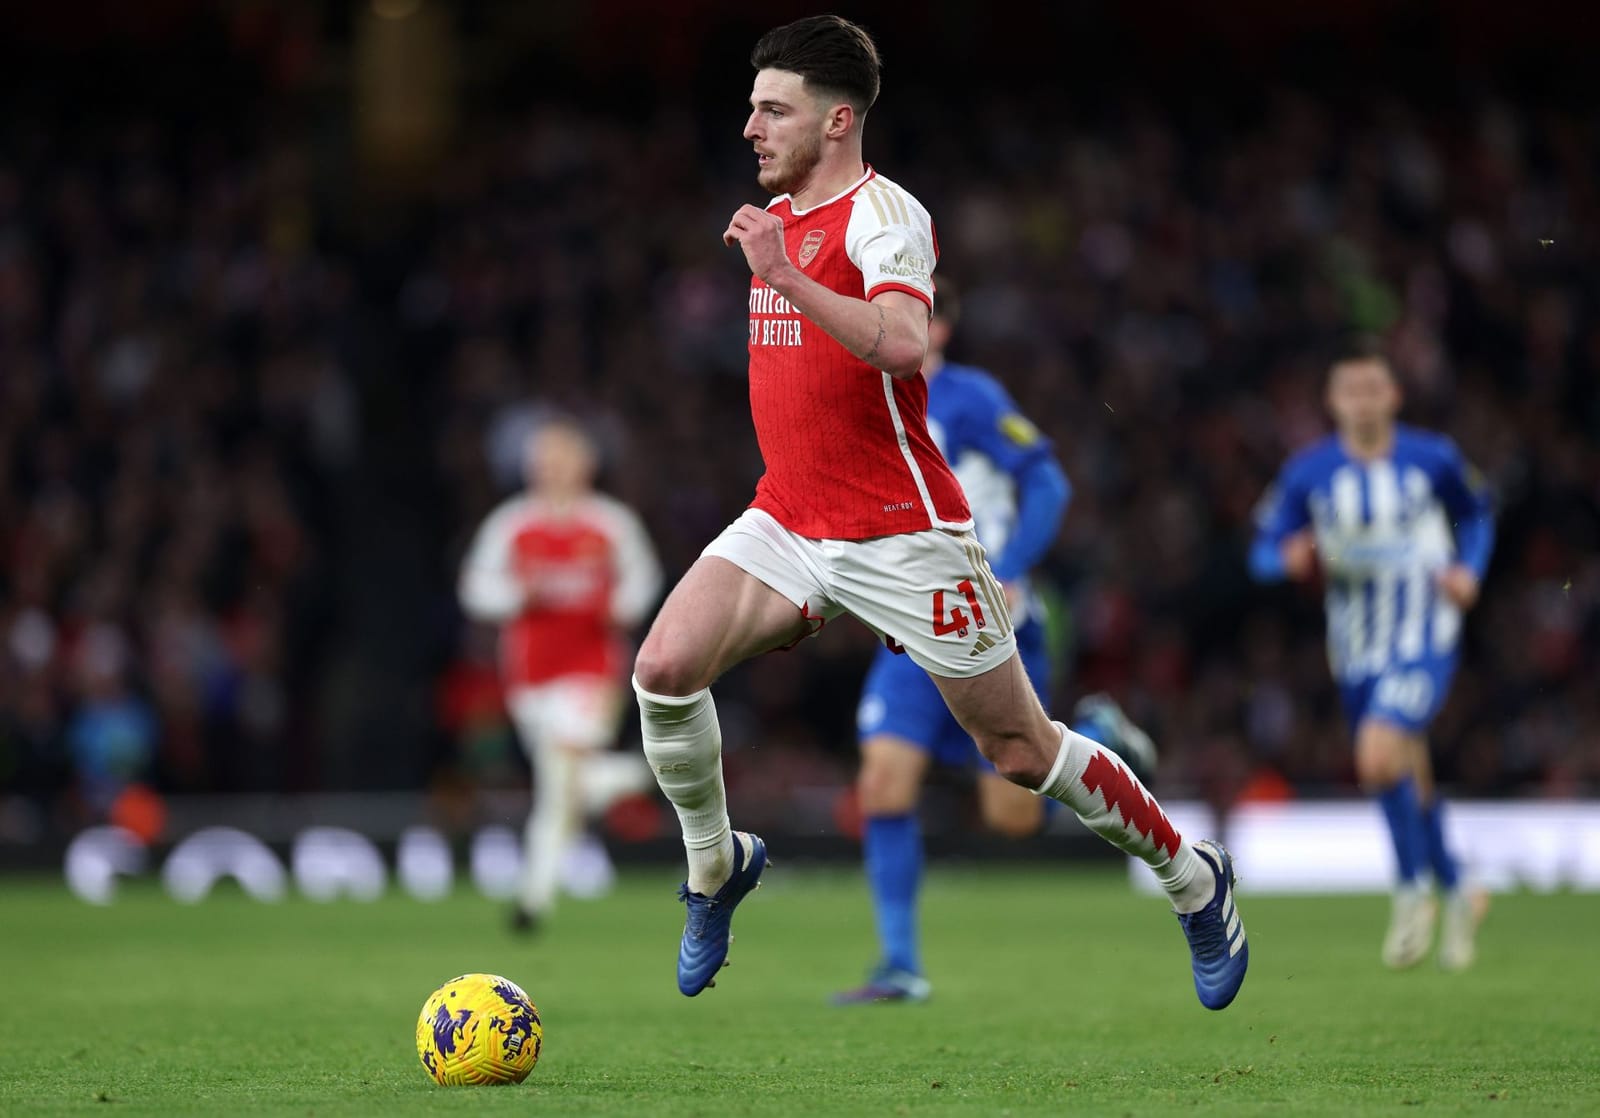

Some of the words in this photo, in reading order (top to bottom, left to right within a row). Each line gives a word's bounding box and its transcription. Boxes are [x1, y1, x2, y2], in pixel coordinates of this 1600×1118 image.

[894, 252, 926, 270] VISIT
[761, 319, 802, 346] BETTER
[932, 577, 986, 638] 41
